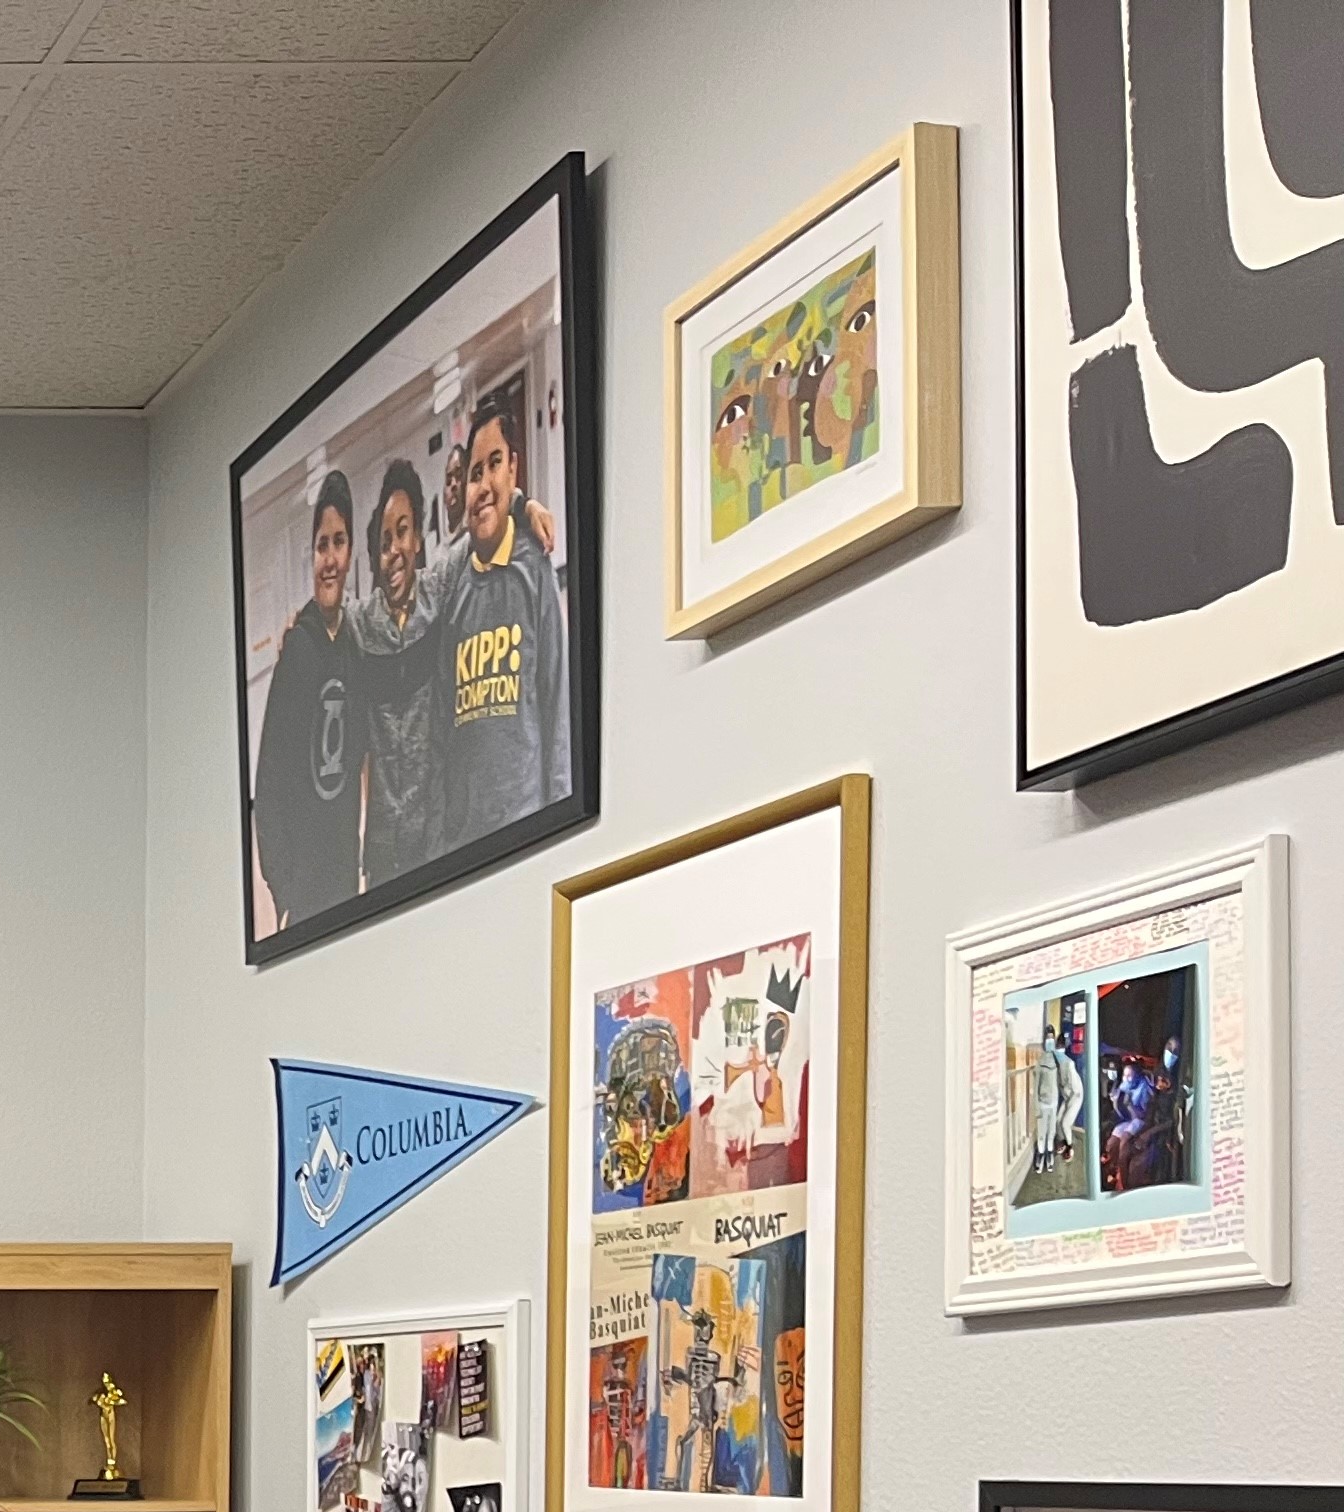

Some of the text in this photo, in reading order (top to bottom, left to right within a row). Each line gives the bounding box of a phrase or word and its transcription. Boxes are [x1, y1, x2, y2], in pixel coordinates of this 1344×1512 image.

[455, 674, 520, 714] COMPTON
[646, 1220, 684, 1241] BASQUIAT
[714, 1212, 788, 1248] BASQUIAT
[590, 1311, 645, 1341] Basquiat
